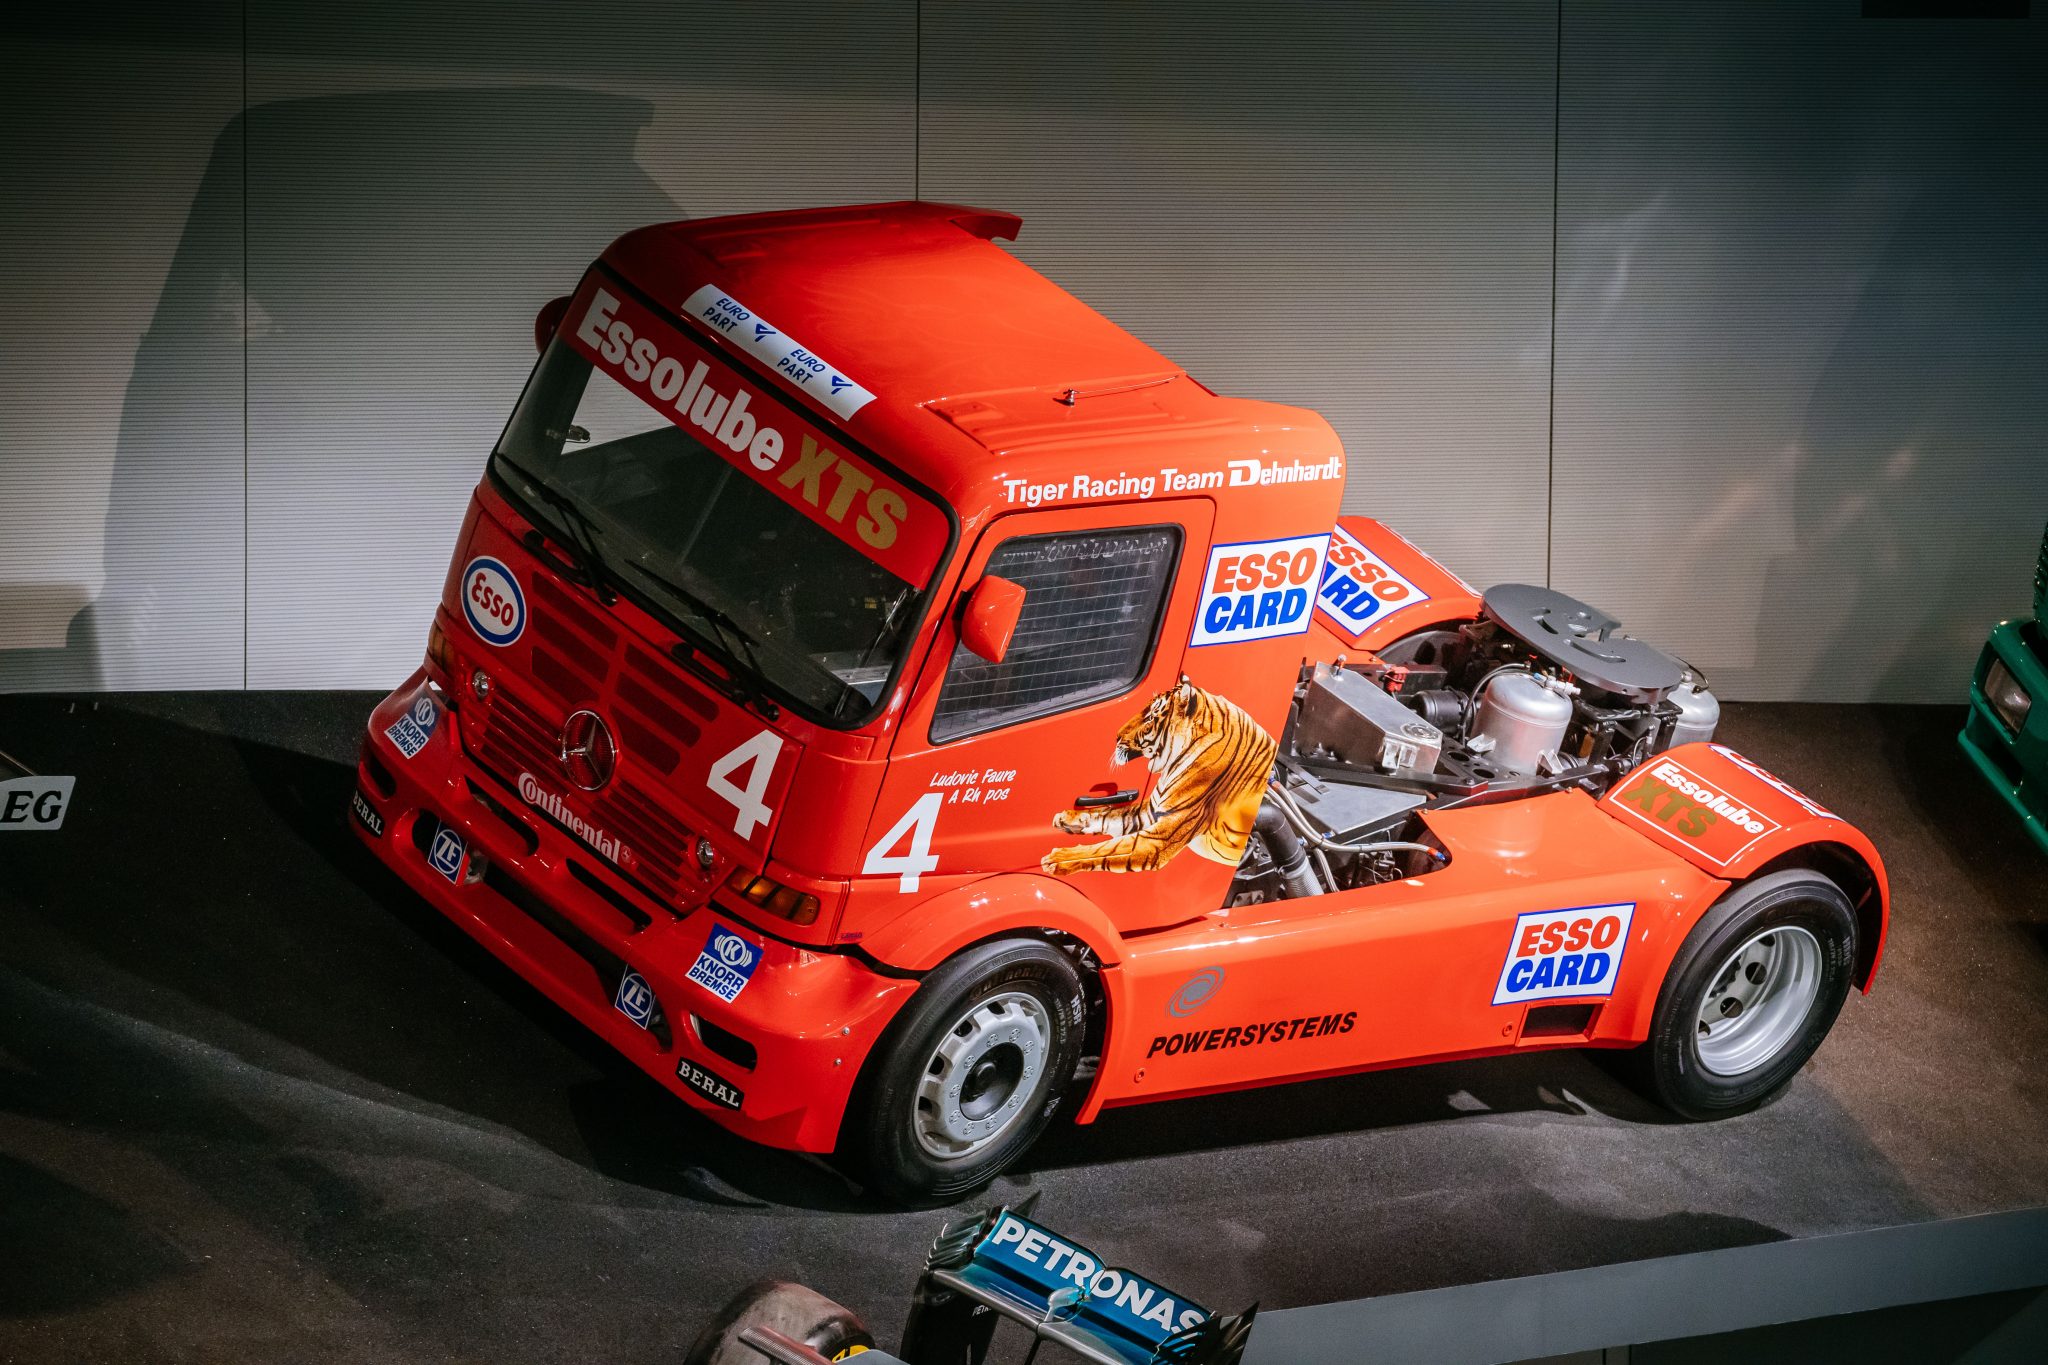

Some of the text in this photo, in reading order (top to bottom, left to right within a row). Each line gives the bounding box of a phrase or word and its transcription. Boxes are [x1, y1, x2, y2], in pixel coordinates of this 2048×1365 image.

[702, 307, 738, 333] PART
[715, 297, 750, 321] EURO
[777, 357, 813, 385] PART
[790, 348, 825, 373] EURO
[576, 288, 907, 549] Essolube XTS
[1003, 456, 1343, 508] Tiger Racing Team Dehnhardt
[1211, 547, 1317, 595] ESSO
[471, 573, 514, 627] ESSO
[1203, 588, 1308, 635] CARD
[387, 726, 417, 757] BREMSE
[397, 715, 426, 749] KNORR
[706, 729, 784, 841] 4
[928, 768, 1017, 788] Ludovic Faure
[948, 787, 1009, 806] A Rh pos
[1650, 762, 1765, 834] Essolube
[353, 790, 382, 836] BERAL
[518, 772, 622, 865] Continental
[1623, 776, 1718, 838] XTS
[861, 793, 944, 894] 4
[1515, 915, 1621, 958] ESSO
[688, 966, 737, 1001] BREMSE
[696, 954, 745, 991] KNORR
[1505, 952, 1611, 993] CARD
[1146, 1011, 1358, 1059] POWERSYSTEMS
[679, 1060, 739, 1108] BERAL
[992, 1217, 1204, 1340] PETRONAS
